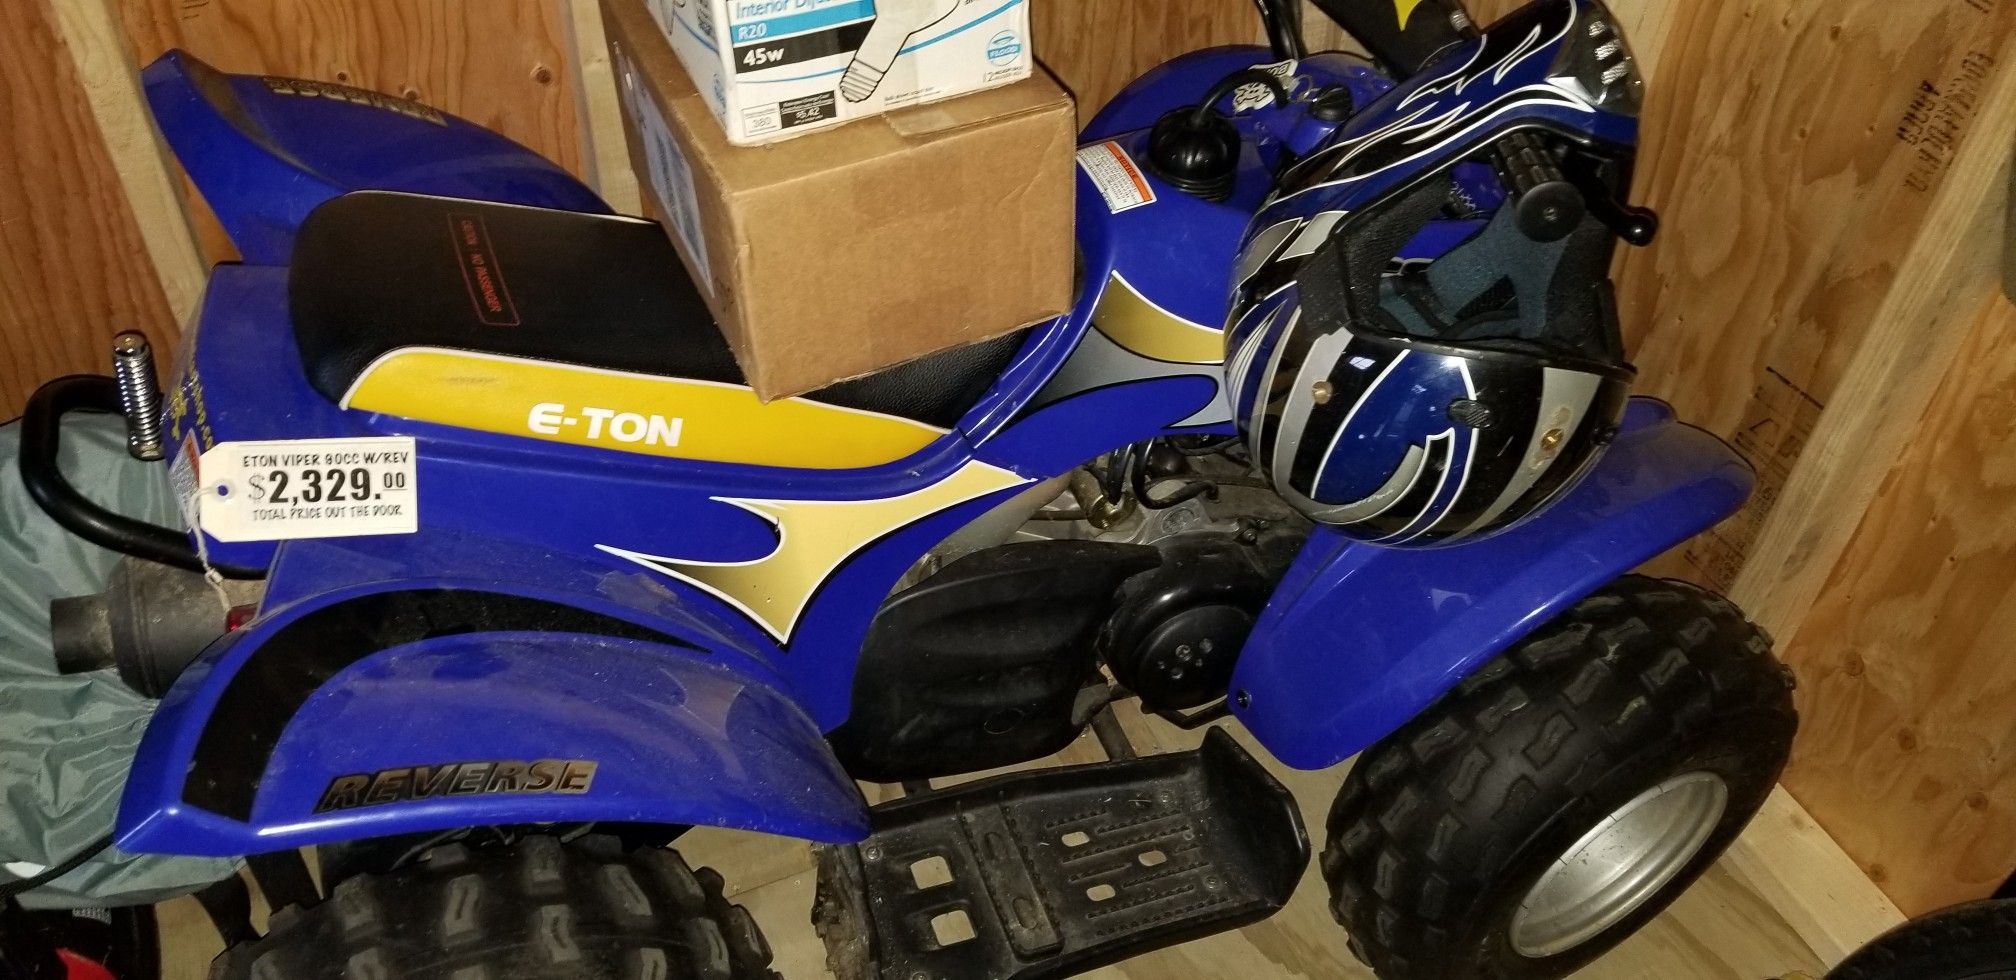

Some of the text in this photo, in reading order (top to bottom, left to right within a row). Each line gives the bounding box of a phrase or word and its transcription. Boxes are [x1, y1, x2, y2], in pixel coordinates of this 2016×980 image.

[738, 23, 767, 40] R20
[528, 402, 683, 447] E-TON
[243, 455, 278, 467] ETON
[281, 454, 320, 467] VIPER
[363, 451, 408, 464] W/REV
[253, 504, 403, 520] TOTAL PRICE OUT THE DOOR
[312, 759, 598, 814] REVERSE
